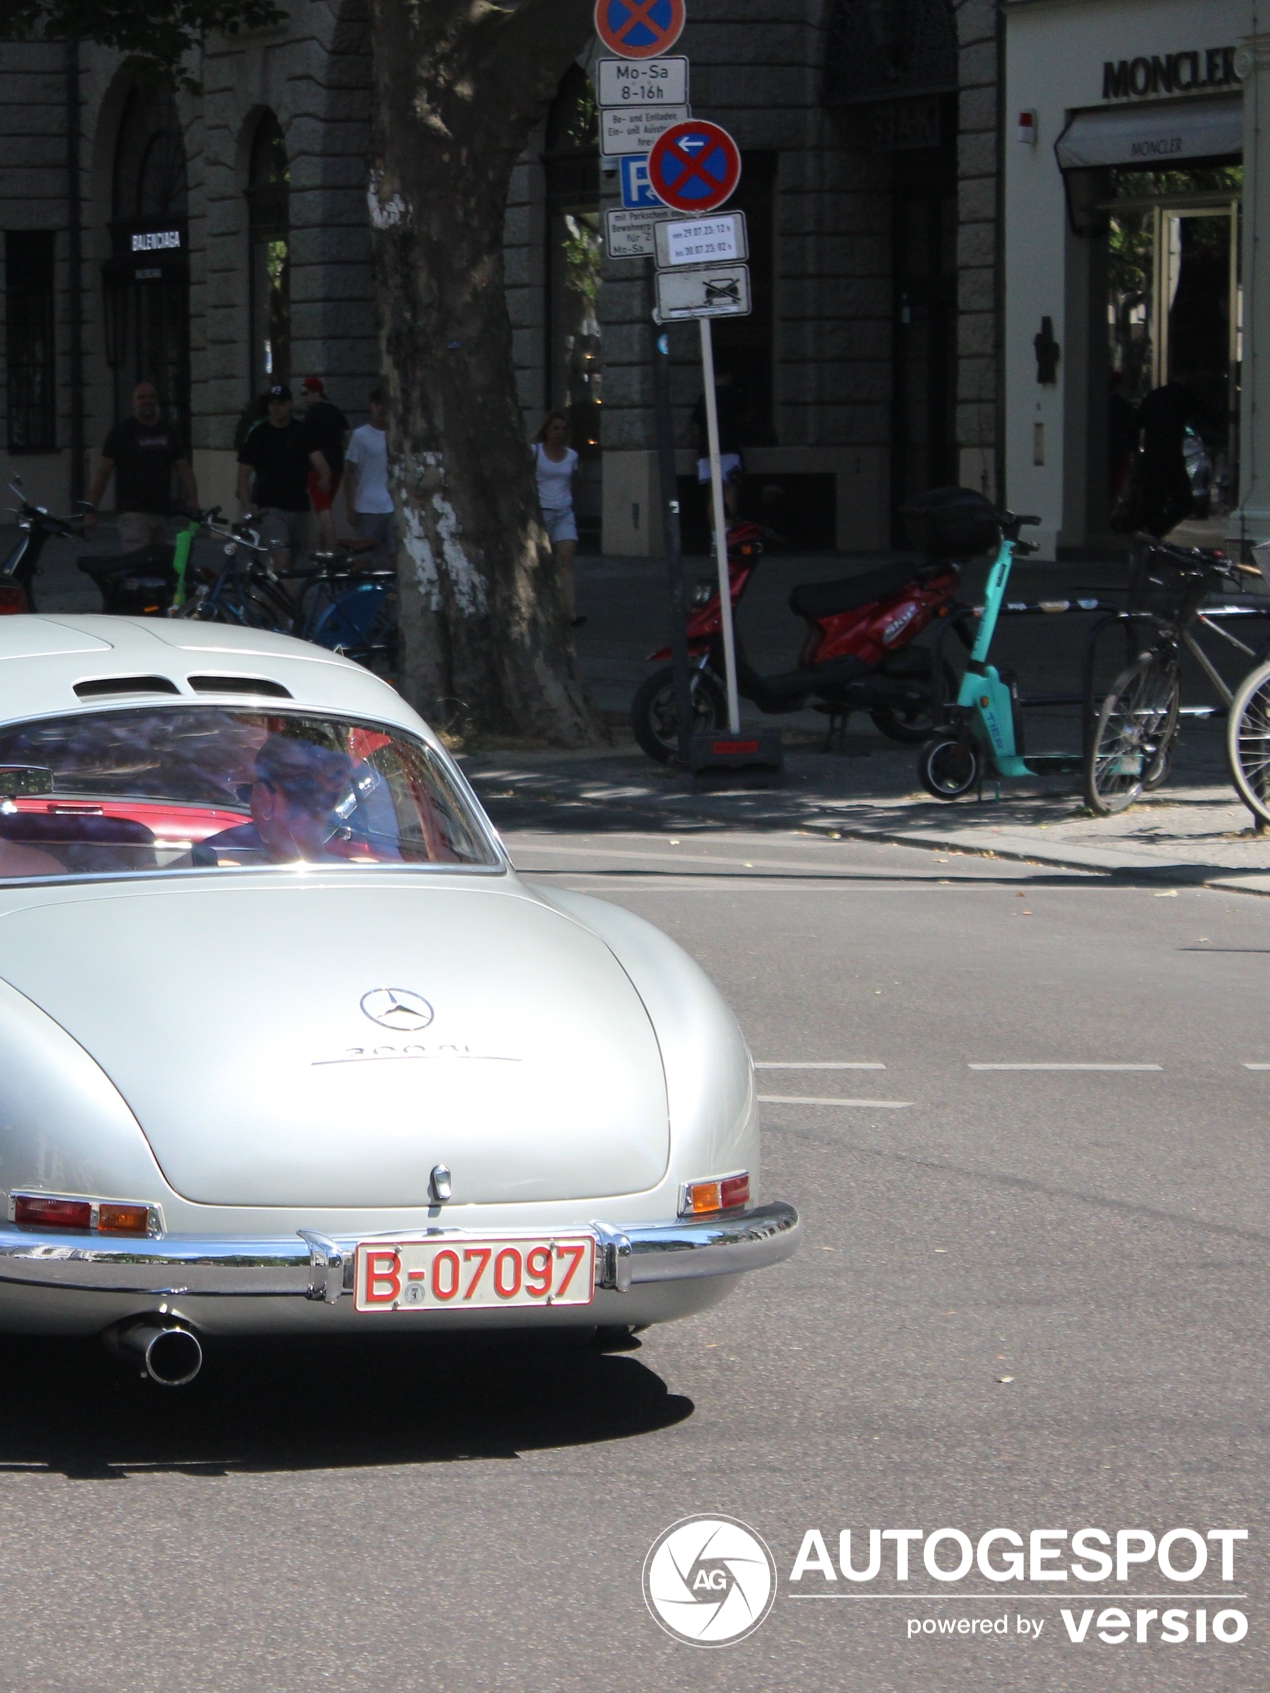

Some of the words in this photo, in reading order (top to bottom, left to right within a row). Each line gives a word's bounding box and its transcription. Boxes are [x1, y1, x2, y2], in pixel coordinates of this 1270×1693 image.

[616, 65, 668, 79] Mo-Sa
[1103, 46, 1243, 99] MONCLER
[621, 85, 664, 100] 8-16h
[613, 114, 626, 124] Be-
[629, 113, 643, 123] und
[645, 112, 678, 122] Entladen
[1130, 138, 1183, 157] MONCLER
[131, 231, 181, 252] BALENCIAGA
[613, 244, 644, 254] Mo-Sa
[986, 712, 1003, 749] TIER
[366, 1245, 585, 1303] B-07097
